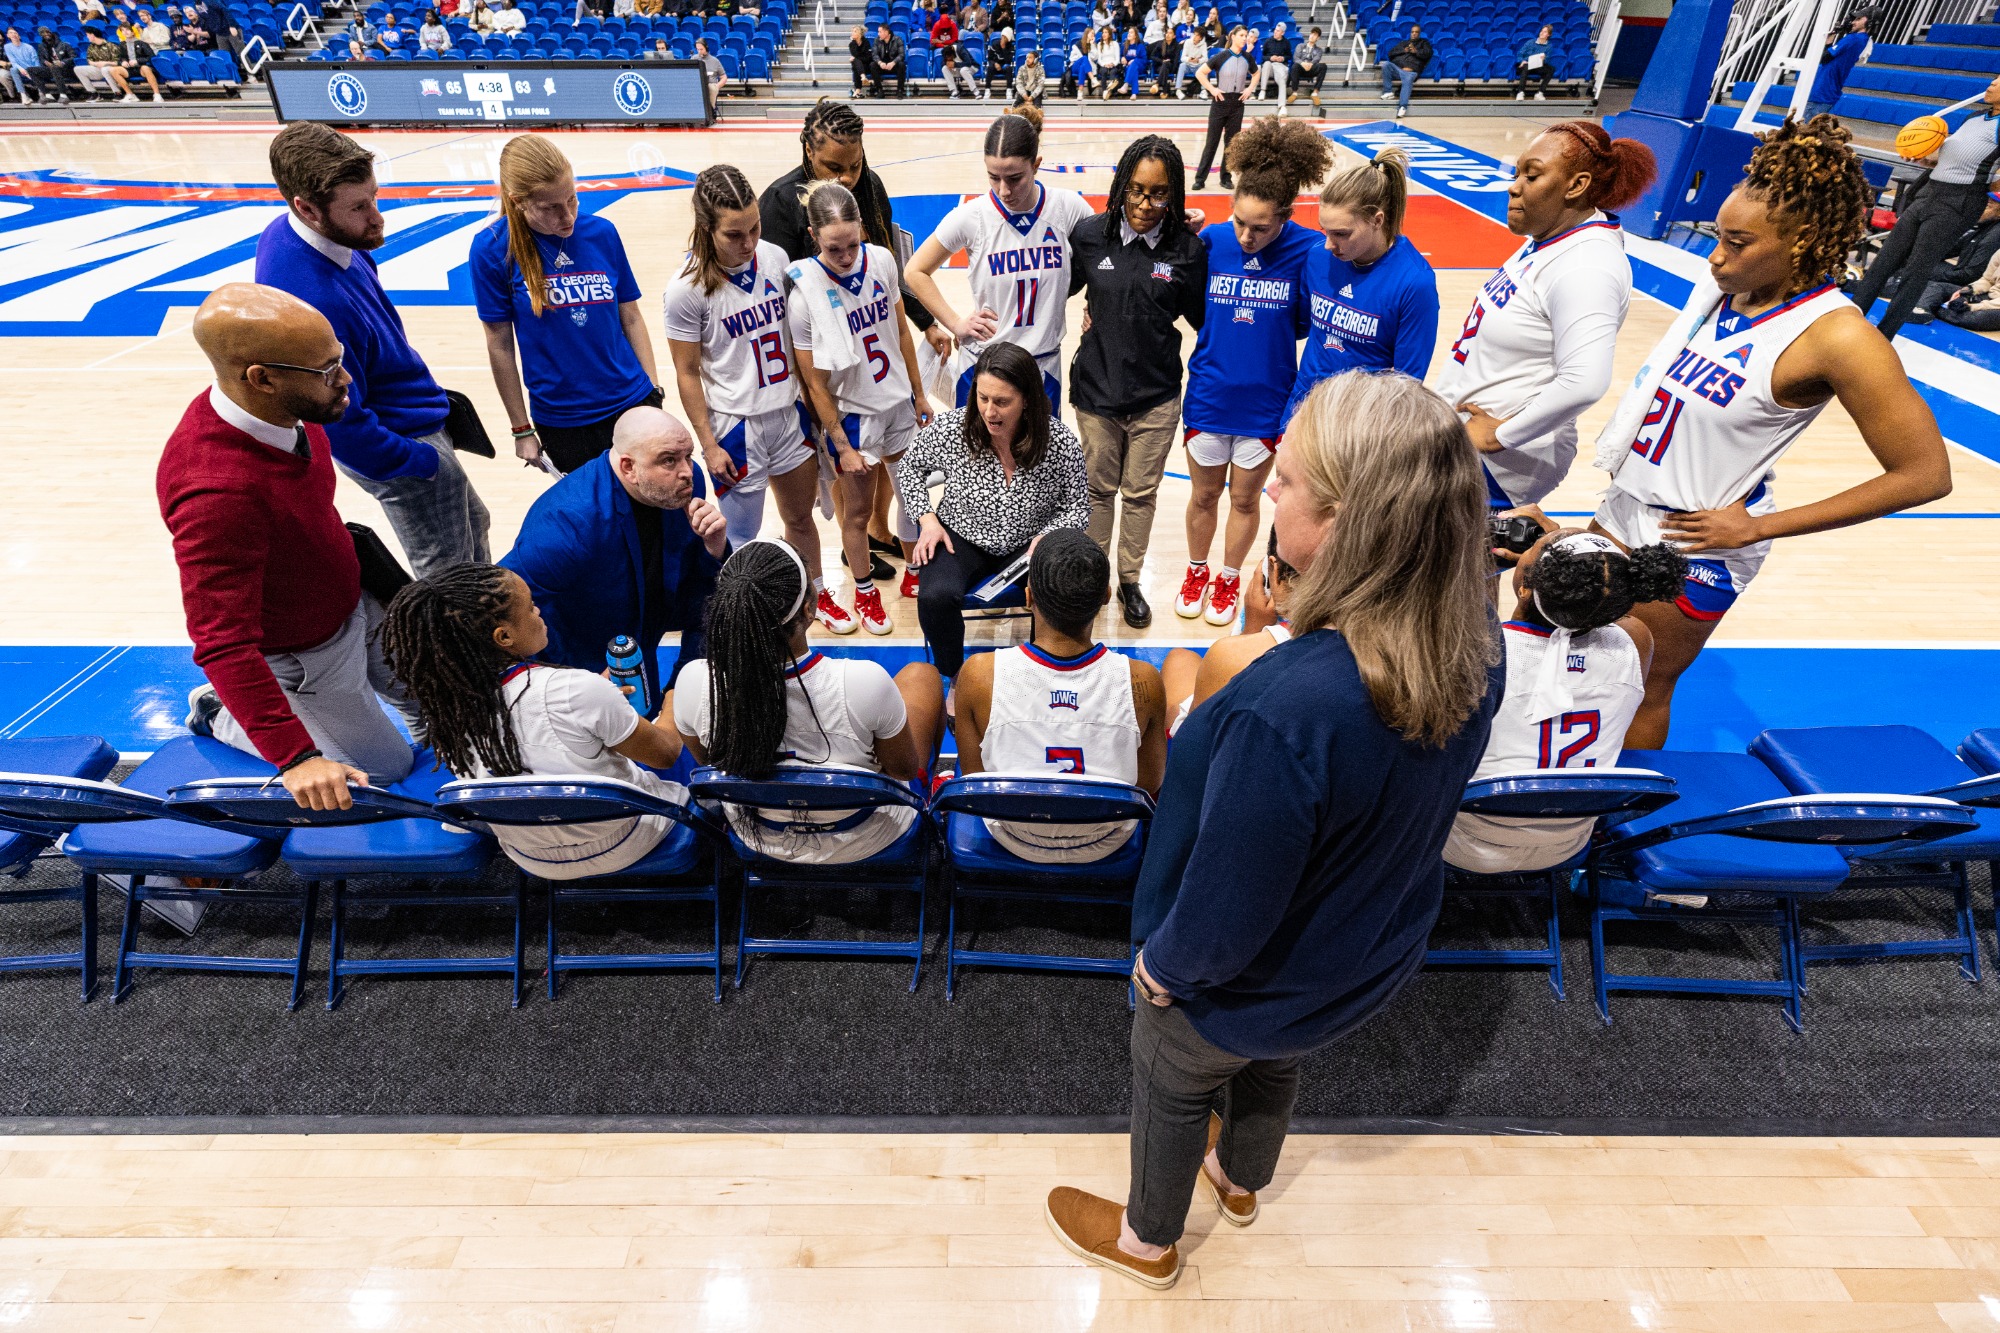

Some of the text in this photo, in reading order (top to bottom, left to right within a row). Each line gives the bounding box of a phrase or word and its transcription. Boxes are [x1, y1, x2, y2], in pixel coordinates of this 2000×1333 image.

[445, 81, 462, 94] 65
[478, 82, 503, 93] 4:38
[514, 80, 531, 94] 63
[438, 108, 455, 116] TEAM
[455, 108, 474, 116] FOULS
[490, 104, 497, 114] 4
[514, 108, 530, 116] TEAM
[531, 108, 550, 116] FOULS
[988, 246, 1063, 276] WOLVES
[1153, 262, 1173, 276] UWG
[561, 274, 610, 286] GEORGIA
[1483, 265, 1518, 309] OLVES
[1209, 275, 1291, 301] WEST GEORGIA
[1013, 277, 1039, 328] 11
[1213, 298, 1280, 309] WOMEN'S BASKETBALL
[721, 296, 786, 339] WOLVES
[1234, 307, 1255, 319] UWG
[1311, 294, 1379, 337] WEST GEORGIA
[1332, 329, 1365, 344] BASKETBALL
[750, 330, 789, 389] 13
[862, 333, 890, 384] 5
[1631, 386, 1685, 466] 21
[1688, 565, 1719, 587] UWG
[1567, 654, 1585, 669] WG
[1051, 690, 1078, 705] UWG
[1537, 709, 1601, 769] 12
